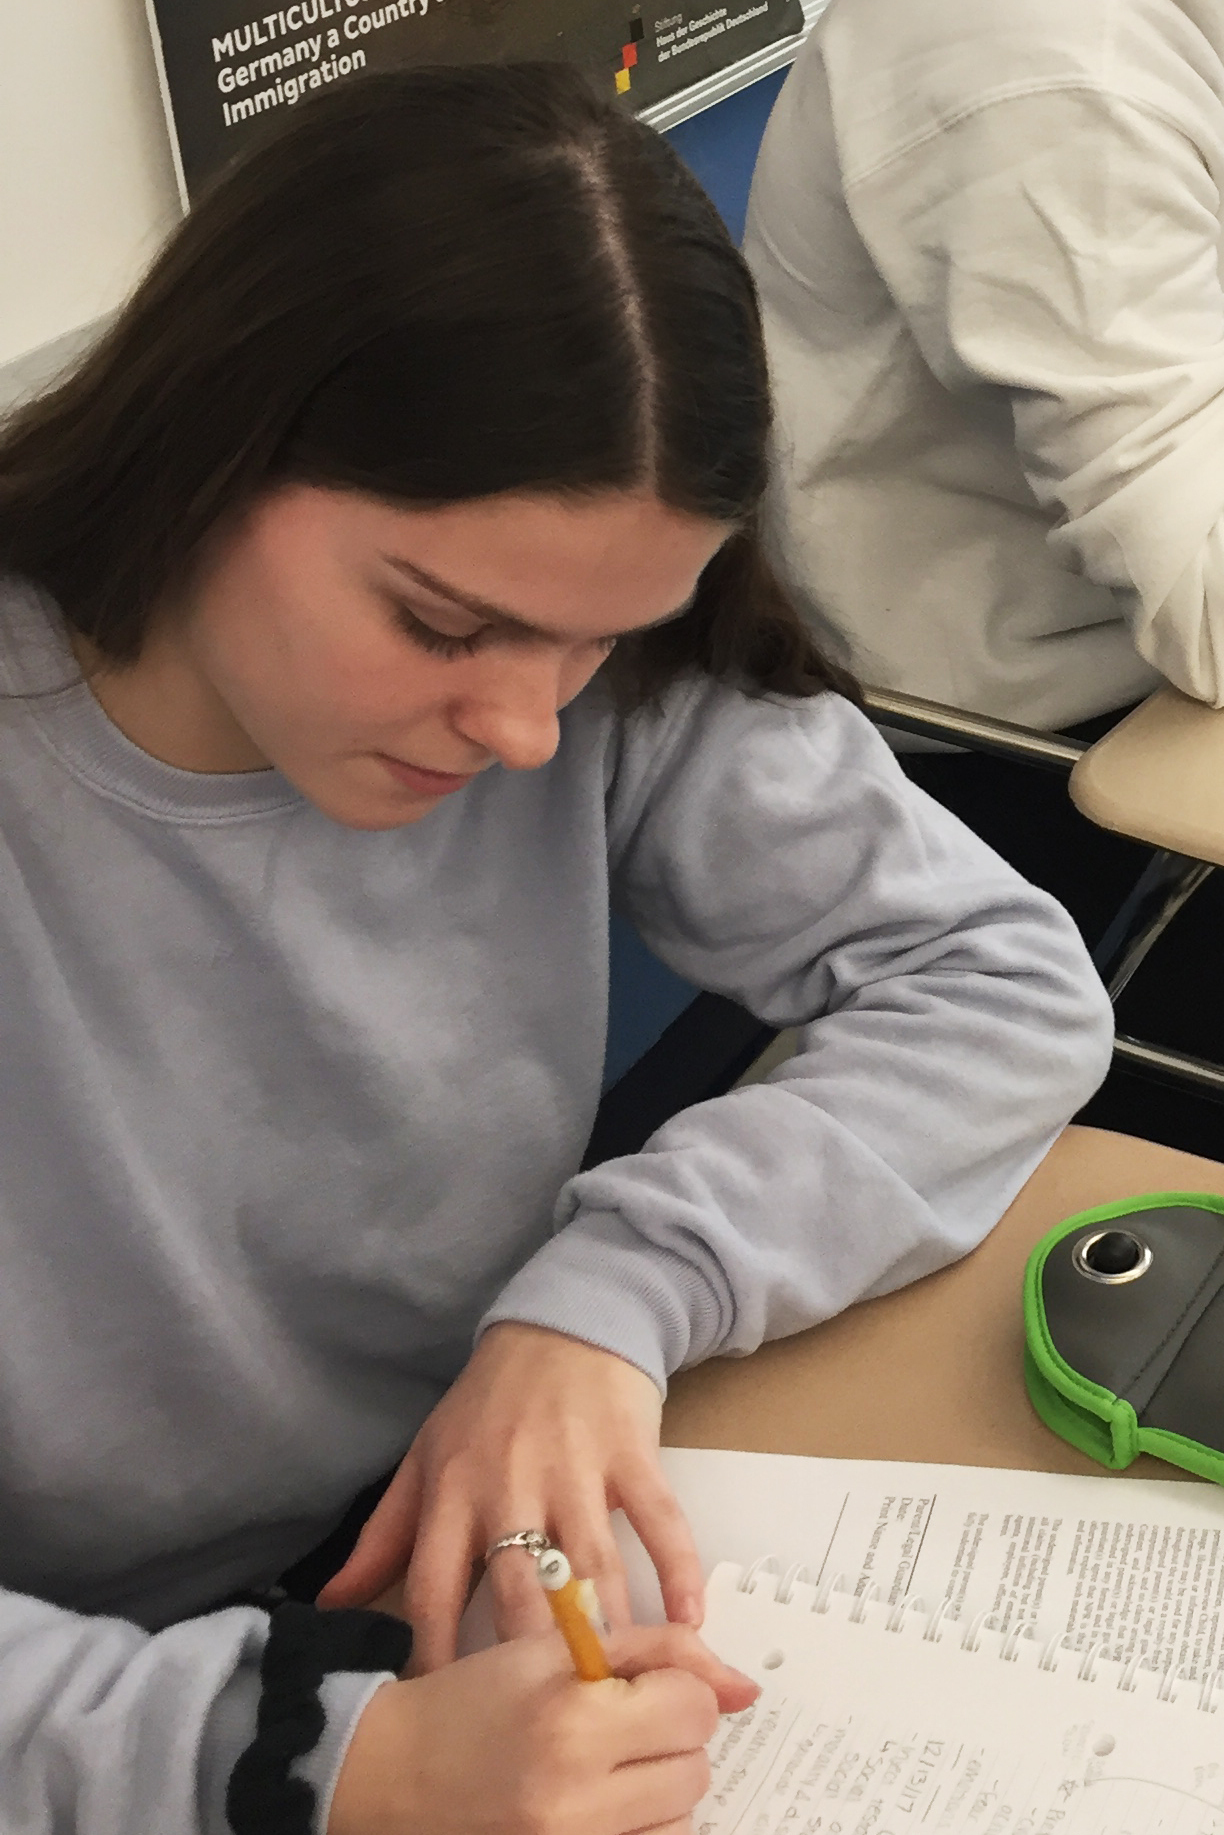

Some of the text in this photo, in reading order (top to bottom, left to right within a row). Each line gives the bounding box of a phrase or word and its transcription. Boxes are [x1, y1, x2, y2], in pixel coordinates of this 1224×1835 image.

[217, 0, 429, 94] Germany a Country
[676, 24, 689, 38] der
[658, 48, 672, 63] der
[222, 49, 367, 127] Immigration
[878, 1496, 896, 1519] Print
[898, 1498, 931, 1558] Parent/Legal
[868, 1521, 888, 1550] Name
[895, 1737, 946, 1814] 12/13/17
